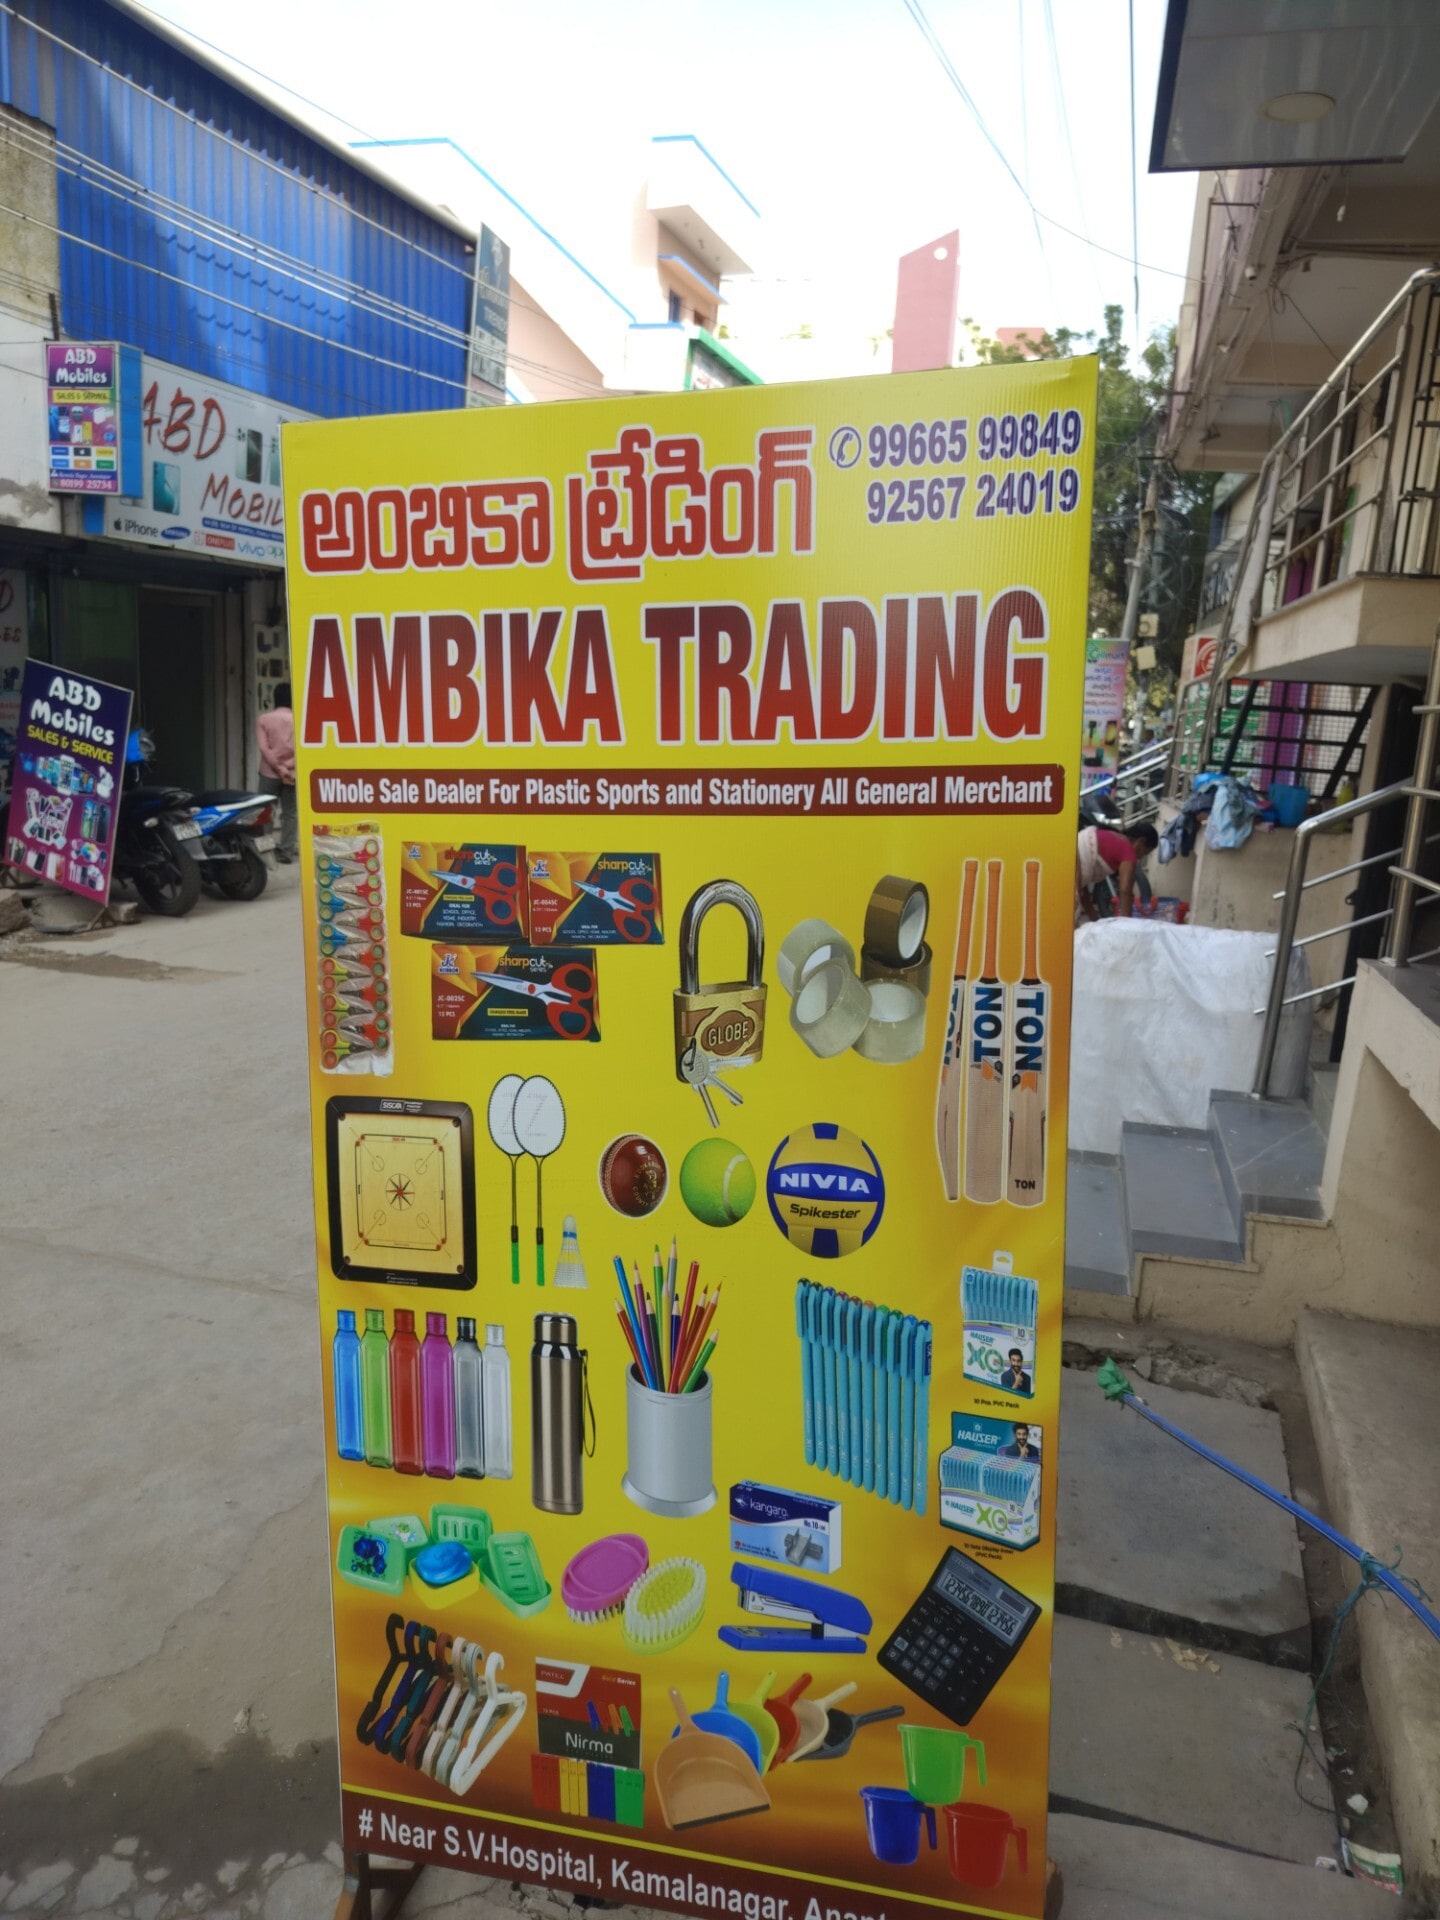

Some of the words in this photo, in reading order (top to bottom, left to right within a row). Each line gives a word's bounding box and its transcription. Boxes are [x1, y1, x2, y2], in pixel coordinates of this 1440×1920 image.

[65, 348, 97, 364] ABD
[56, 367, 107, 384] Mobiles
[142, 381, 226, 461] ABD
[869, 419, 967, 468] 99665
[979, 410, 1082, 461] 99849
[868, 476, 966, 524] 92567
[976, 468, 1080, 518] 24019
[125, 518, 158, 538] iPhone
[302, 481, 550, 573] అంబికా
[304, 609, 622, 744] AMBIKA
[645, 589, 1046, 742] TRADING
[48, 676, 102, 712] ABD
[30, 699, 115, 747] Mobiles
[27, 724, 59, 749] SALES
[60, 736, 70, 750] &
[72, 739, 115, 765] SERVICE
[318, 778, 374, 804] Whole
[380, 778, 420, 804] Sale
[424, 779, 484, 804] Dealer
[489, 779, 521, 803] For
[525, 778, 591, 804] Plastic
[595, 778, 660, 811] Sports
[665, 778, 703, 804] and
[709, 777, 815, 811] Stationery
[821, 777, 848, 804] All
[855, 776, 938, 804] General
[945, 774, 1053, 804] Merchant
[597, 857, 646, 874] sharpcut
[499, 955, 546, 969] sharpcut
[707, 1019, 749, 1046] GLOBE
[973, 986, 1003, 1063] TON
[1015, 991, 1045, 1072] TON
[779, 1172, 871, 1194] NIVIA
[1014, 1179, 1036, 1190] TON
[789, 1202, 861, 1221] Spikester
[970, 1331, 996, 1344] HAUSER
[957, 1429, 998, 1446] HAUSER
[749, 1498, 787, 1518] kangaro
[950, 1501, 976, 1515] HAUSER
[616, 1677, 637, 1687] Series
[565, 1731, 614, 1754] Nirma
[359, 1808, 374, 1838] #
[380, 1812, 437, 1850] Near
[443, 1825, 602, 1890] S.V.Hospital,
